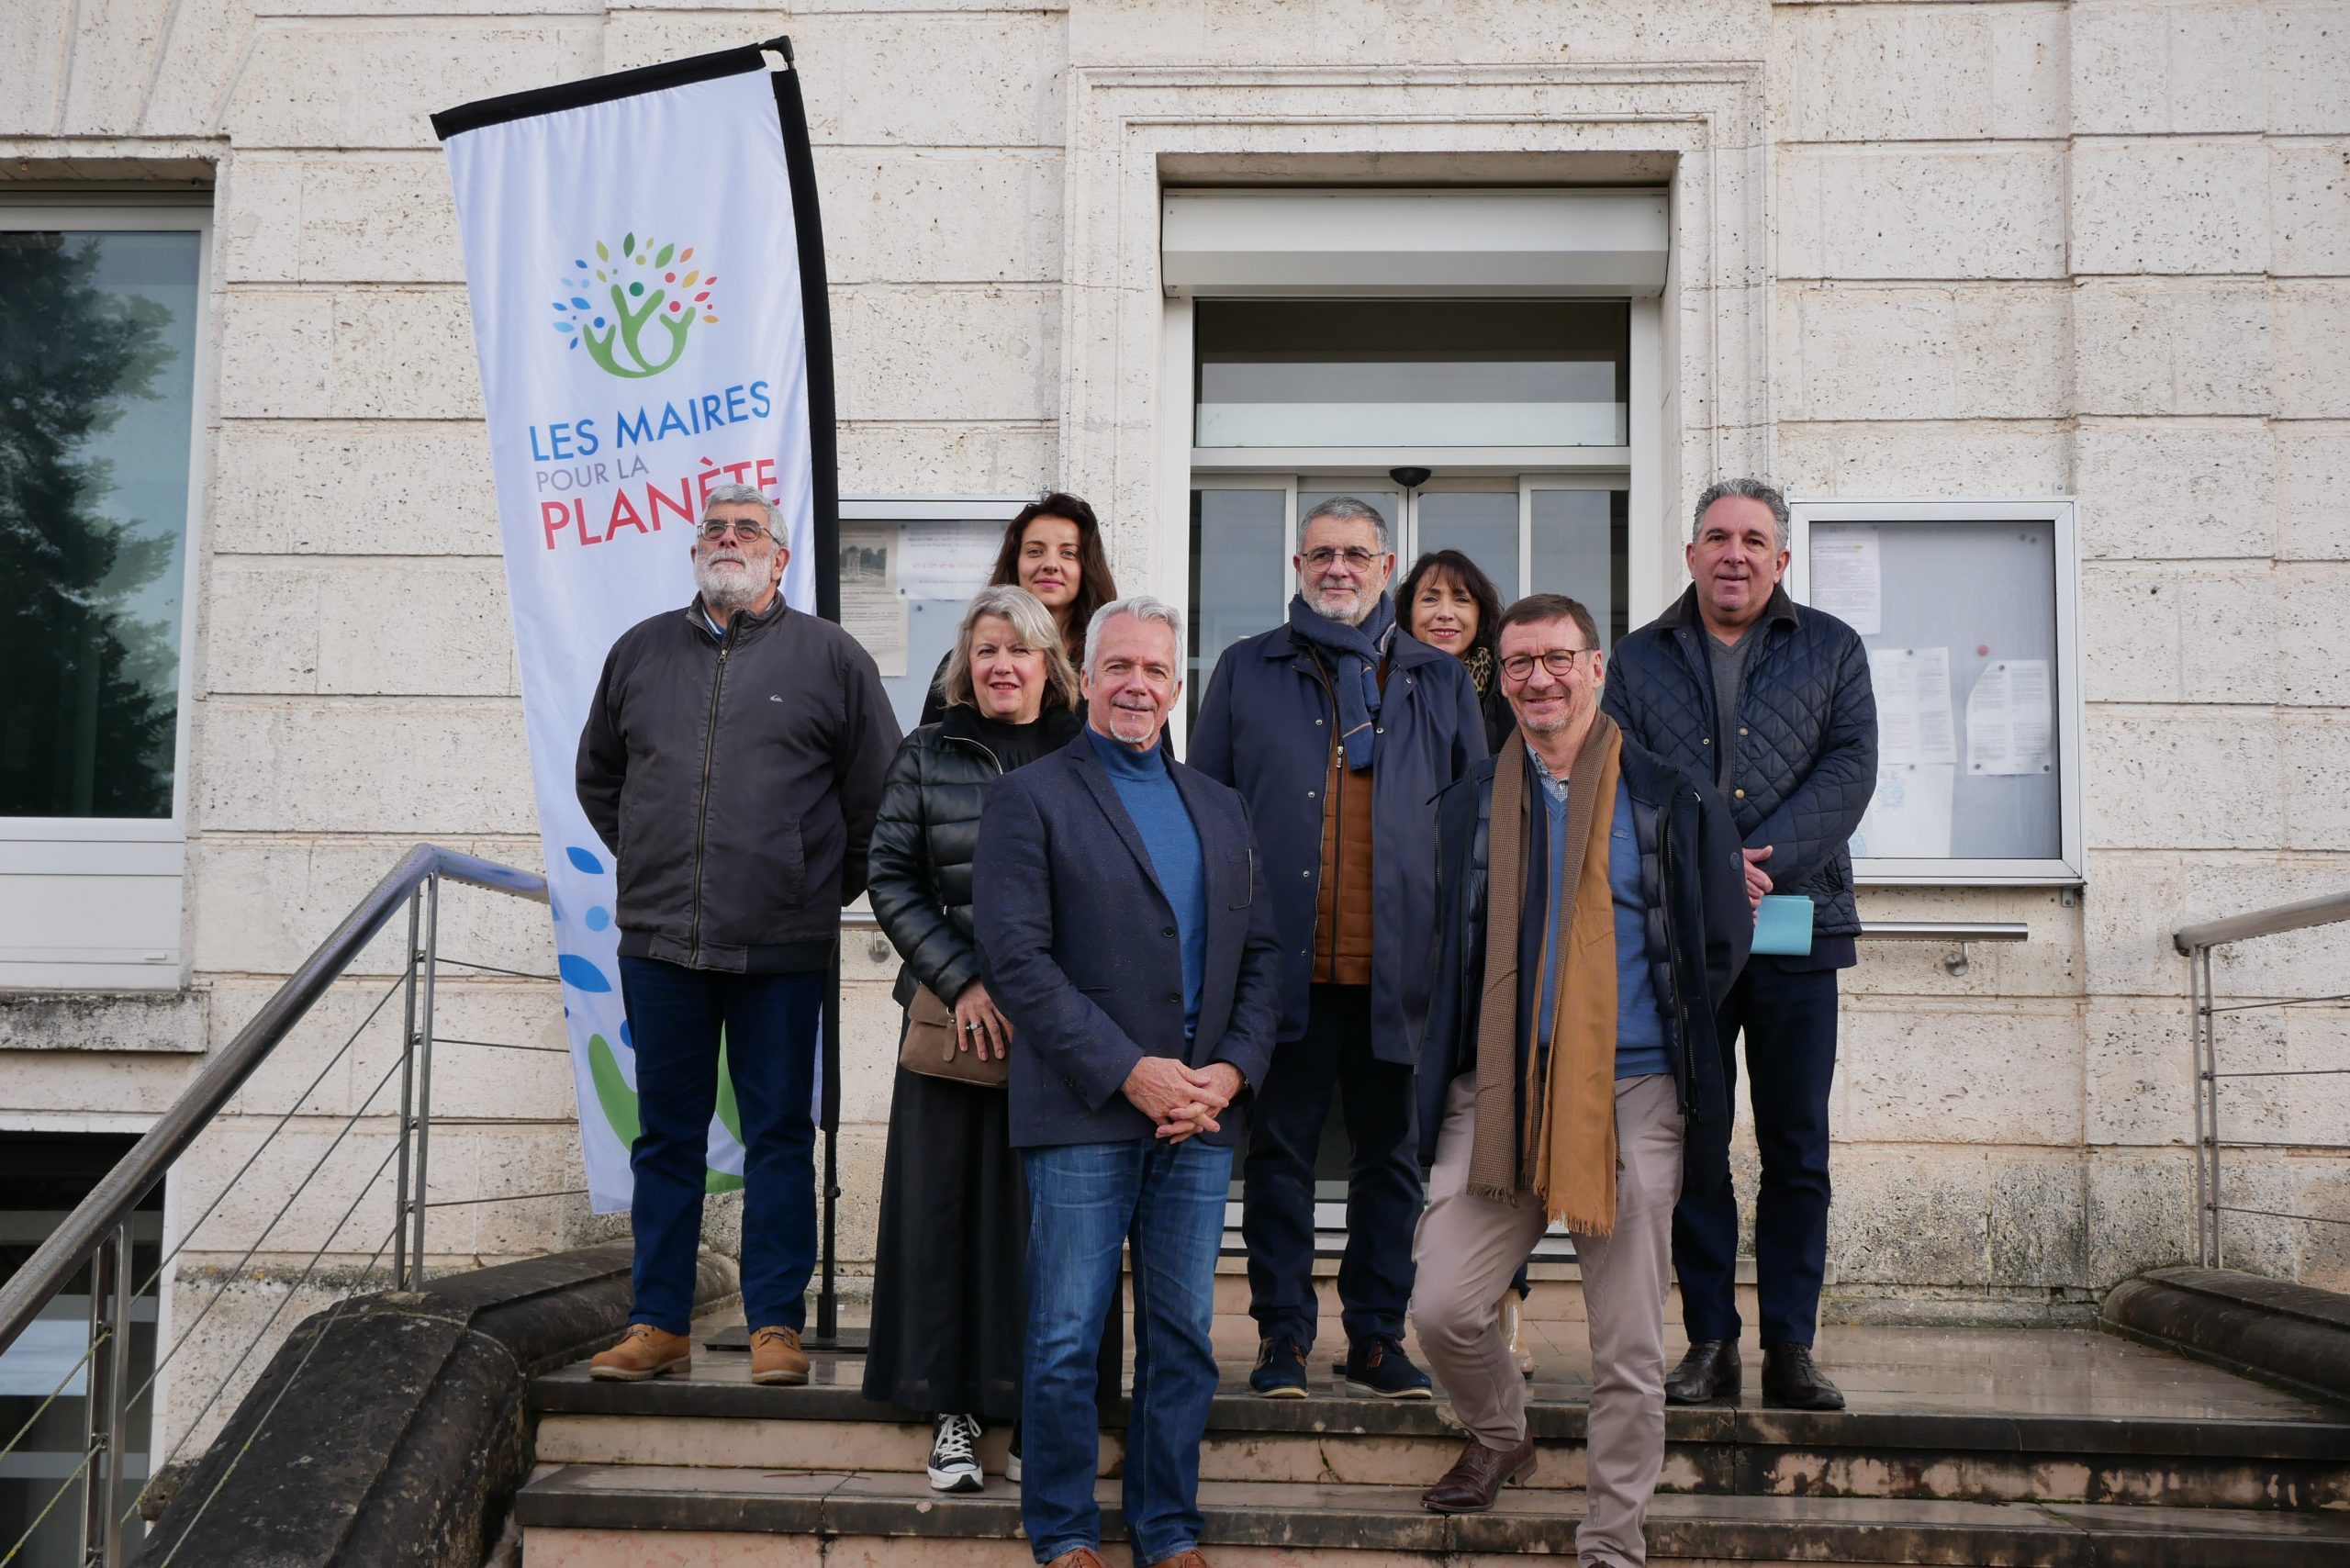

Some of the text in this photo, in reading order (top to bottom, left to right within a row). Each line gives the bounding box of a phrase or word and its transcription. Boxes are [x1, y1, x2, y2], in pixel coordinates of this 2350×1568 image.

[530, 380, 770, 461] LES MAIRES
[536, 454, 649, 492] POUR LA
